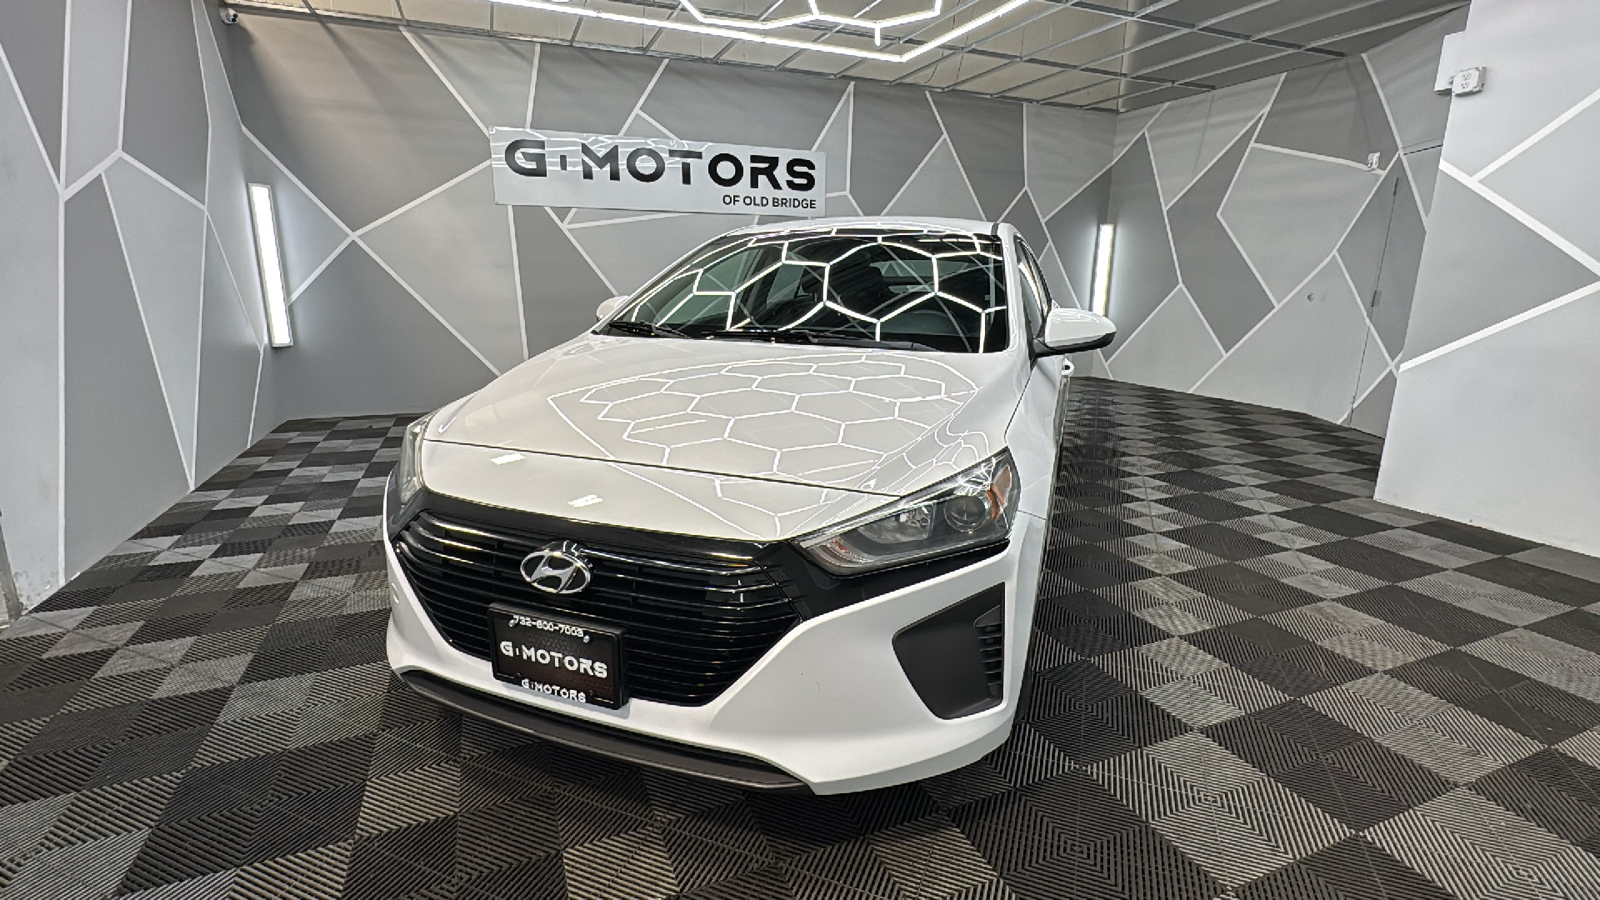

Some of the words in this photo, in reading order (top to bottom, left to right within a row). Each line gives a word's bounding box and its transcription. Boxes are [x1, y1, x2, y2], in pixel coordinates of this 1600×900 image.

[722, 194, 740, 206] OF
[742, 195, 769, 207] OLD
[772, 197, 817, 209] BRIDGE
[512, 614, 584, 637] 732-800-7003
